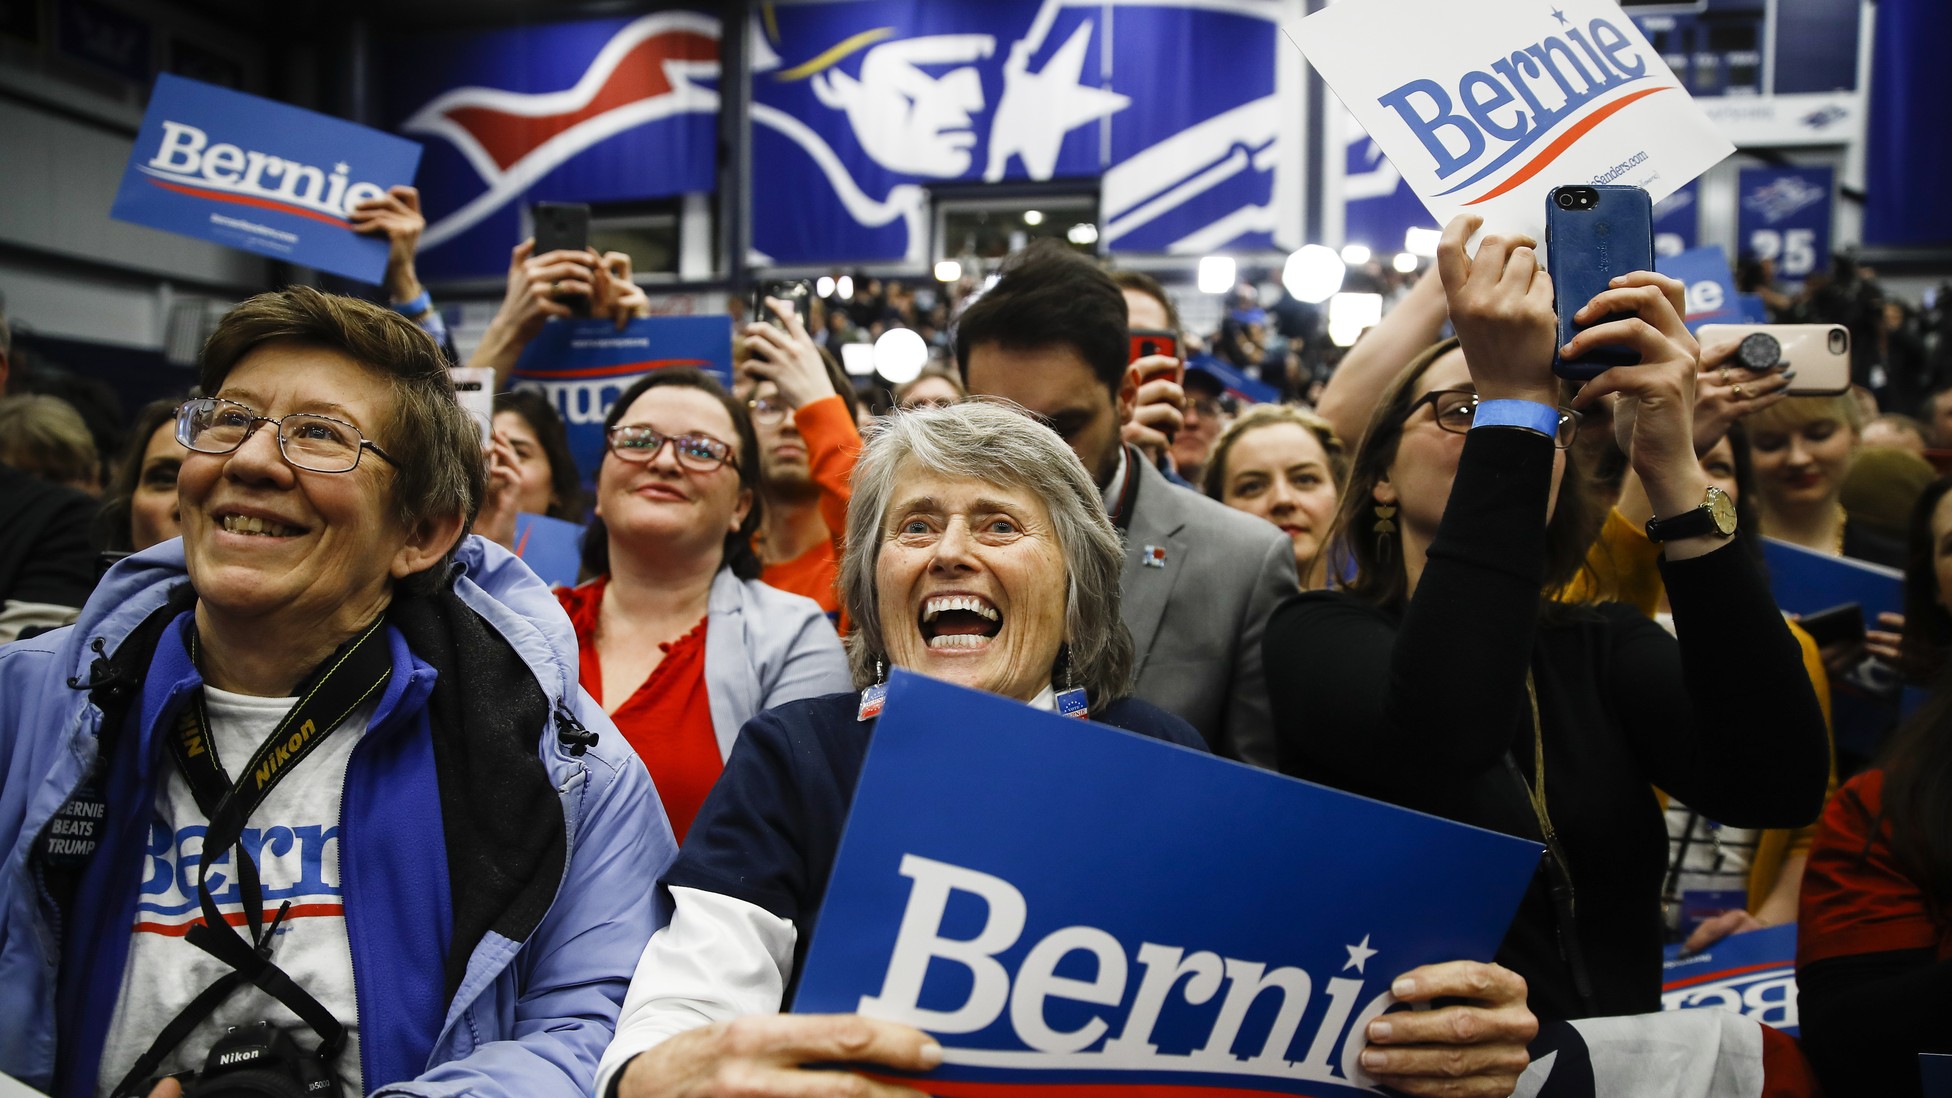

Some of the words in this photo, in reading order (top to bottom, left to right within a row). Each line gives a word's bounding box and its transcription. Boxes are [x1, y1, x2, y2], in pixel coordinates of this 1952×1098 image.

[1377, 5, 1647, 180] Bernie
[1586, 150, 1649, 186] Sanders.com
[255, 718, 317, 791] Nikon
[51, 818, 95, 837] BEATS
[47, 838, 96, 855] TRUMP
[139, 824, 341, 898] Bern
[219, 1049, 259, 1065] Nikon
